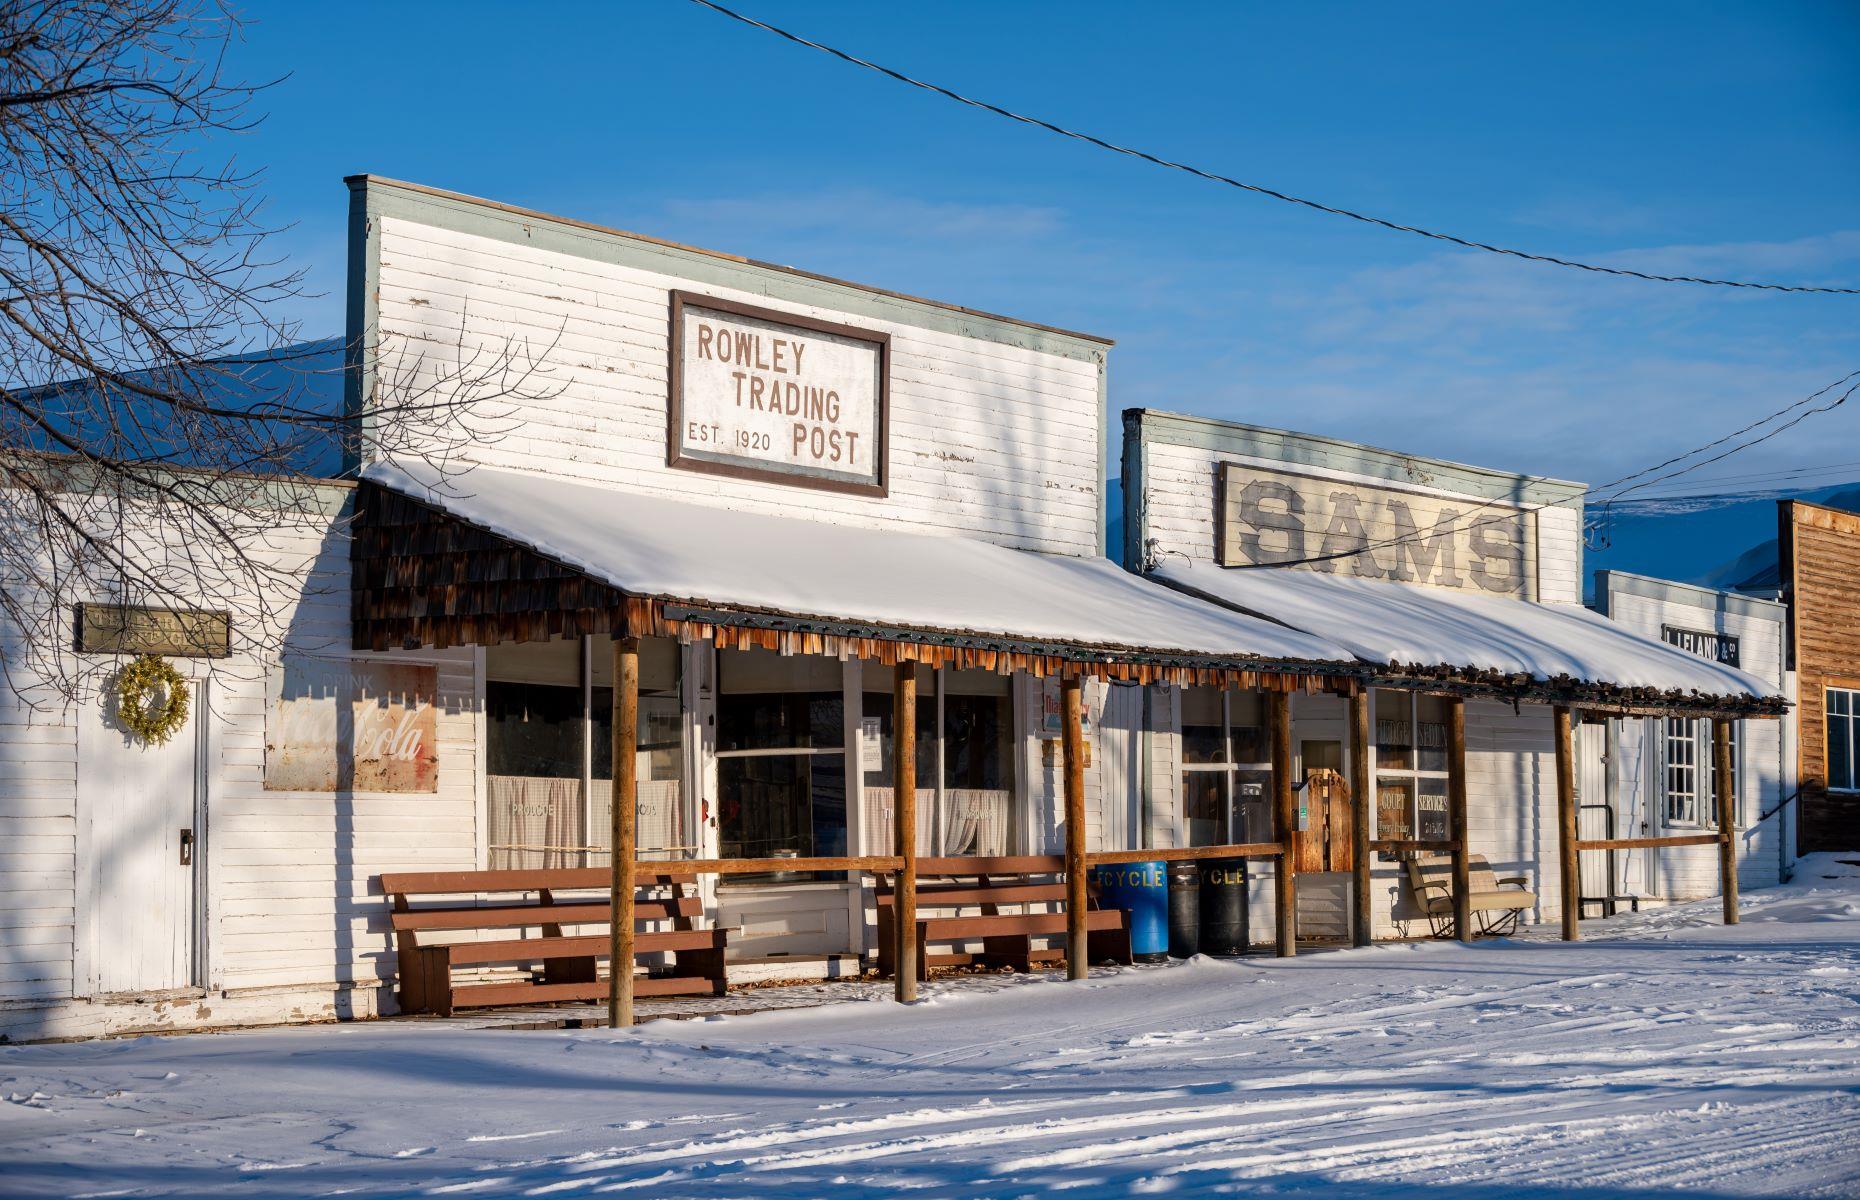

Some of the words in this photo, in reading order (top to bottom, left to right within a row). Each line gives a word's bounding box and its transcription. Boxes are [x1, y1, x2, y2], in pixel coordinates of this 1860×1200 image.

[698, 324, 805, 375] ROWLEY
[732, 371, 840, 423] TRADING
[688, 422, 724, 445] EST.
[735, 429, 770, 450] 1920
[793, 423, 858, 464] POST
[1239, 479, 1524, 594] SAMS
[321, 672, 373, 690] DRINK
[1419, 795, 1448, 812] SERVICES
[1097, 870, 1163, 887] CYCLE
